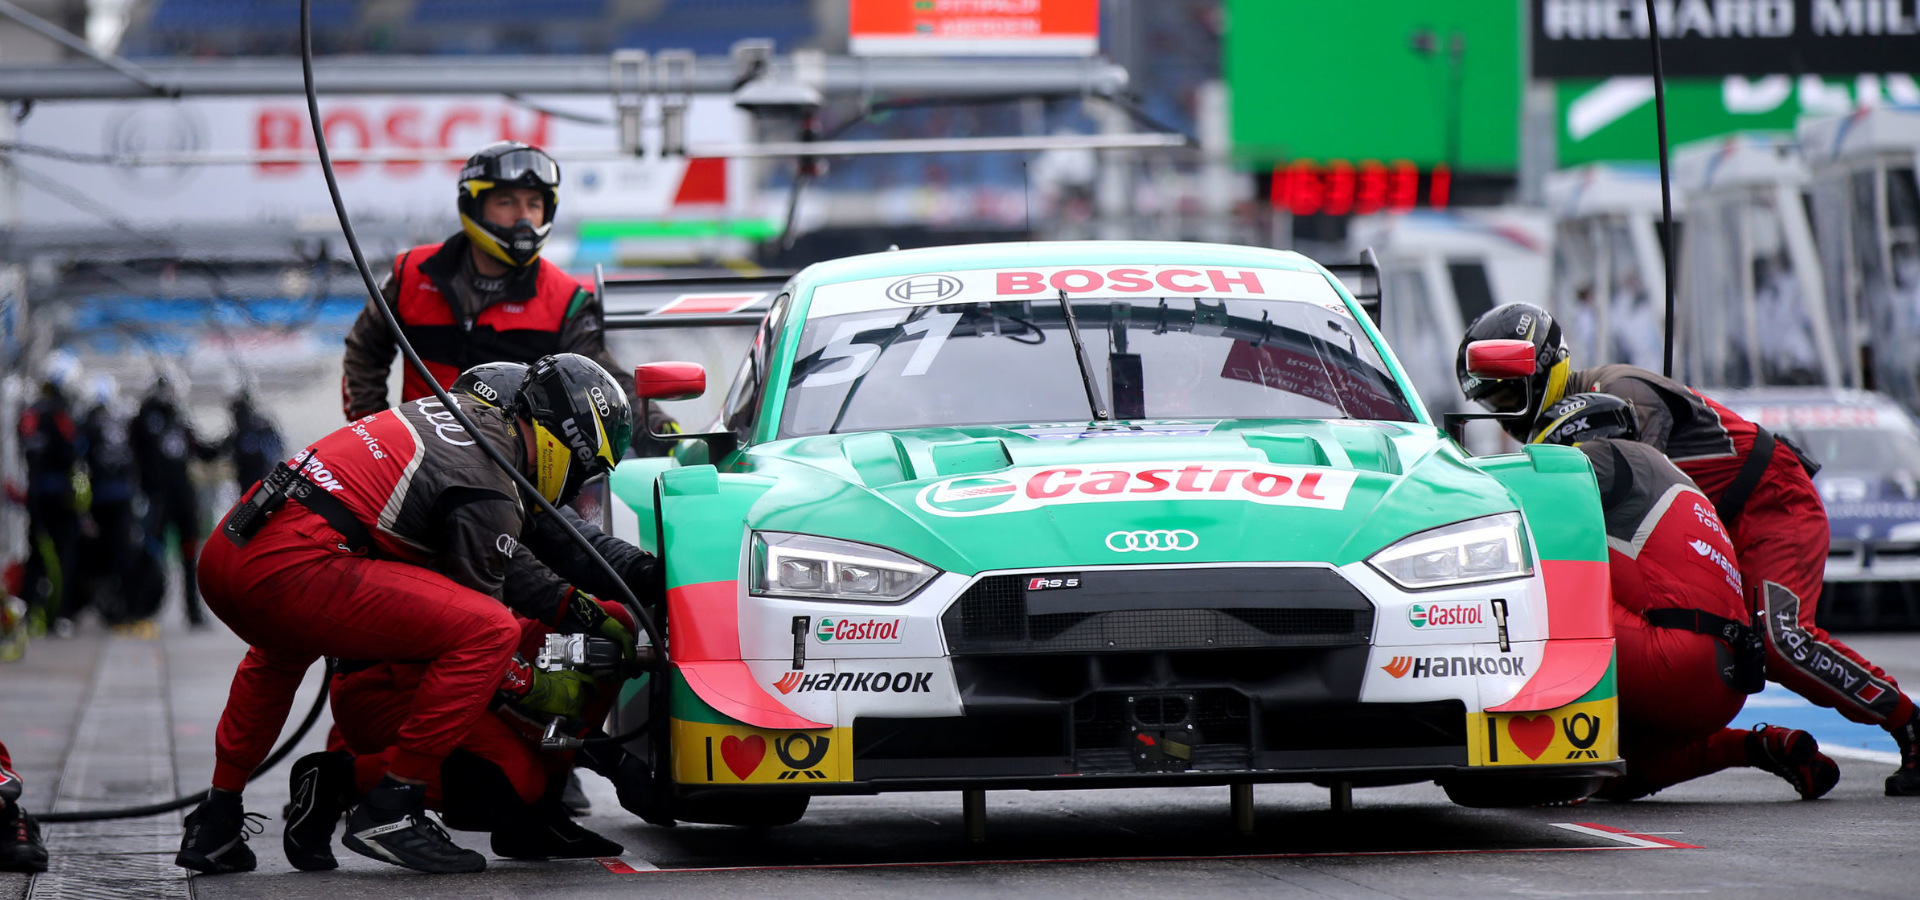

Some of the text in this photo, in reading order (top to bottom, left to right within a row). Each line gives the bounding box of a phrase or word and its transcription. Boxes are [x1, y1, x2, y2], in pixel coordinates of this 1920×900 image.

[997, 268, 1265, 296] BOSCH
[802, 312, 964, 388] 51
[351, 424, 386, 461] Service
[562, 418, 598, 471] uvex
[1551, 416, 1590, 443] vex
[1025, 465, 1325, 500] Castrol
[1036, 578, 1079, 588] RS 5
[835, 619, 900, 640] Castrol
[1428, 604, 1483, 626] Castrol
[1810, 651, 1859, 689] Audi
[1487, 717, 1499, 763] I
[705, 736, 714, 781] I
